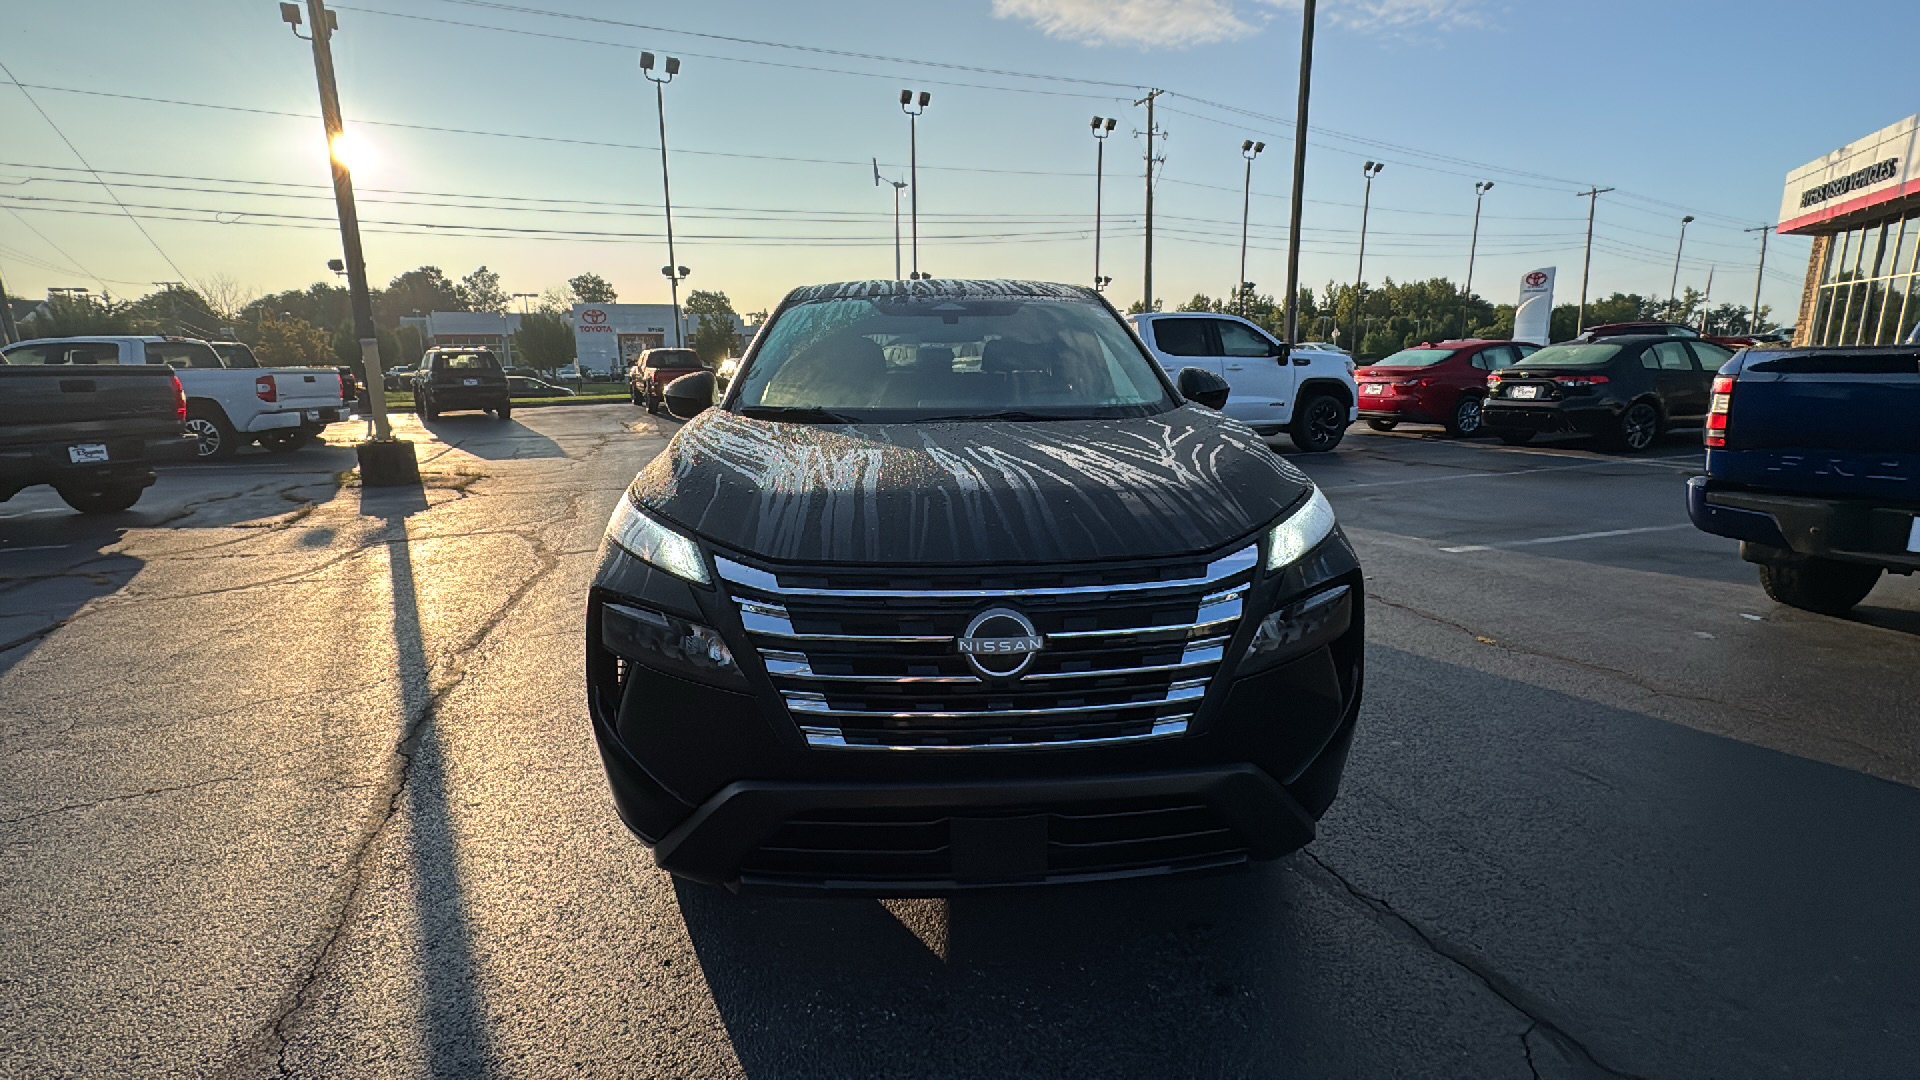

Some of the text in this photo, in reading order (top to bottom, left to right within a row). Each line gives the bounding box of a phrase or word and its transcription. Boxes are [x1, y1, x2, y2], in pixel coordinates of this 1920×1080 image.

[1825, 176, 1850, 199] USED
[1849, 157, 1898, 191] VEHICLES
[960, 639, 1041, 652] NISSAN
